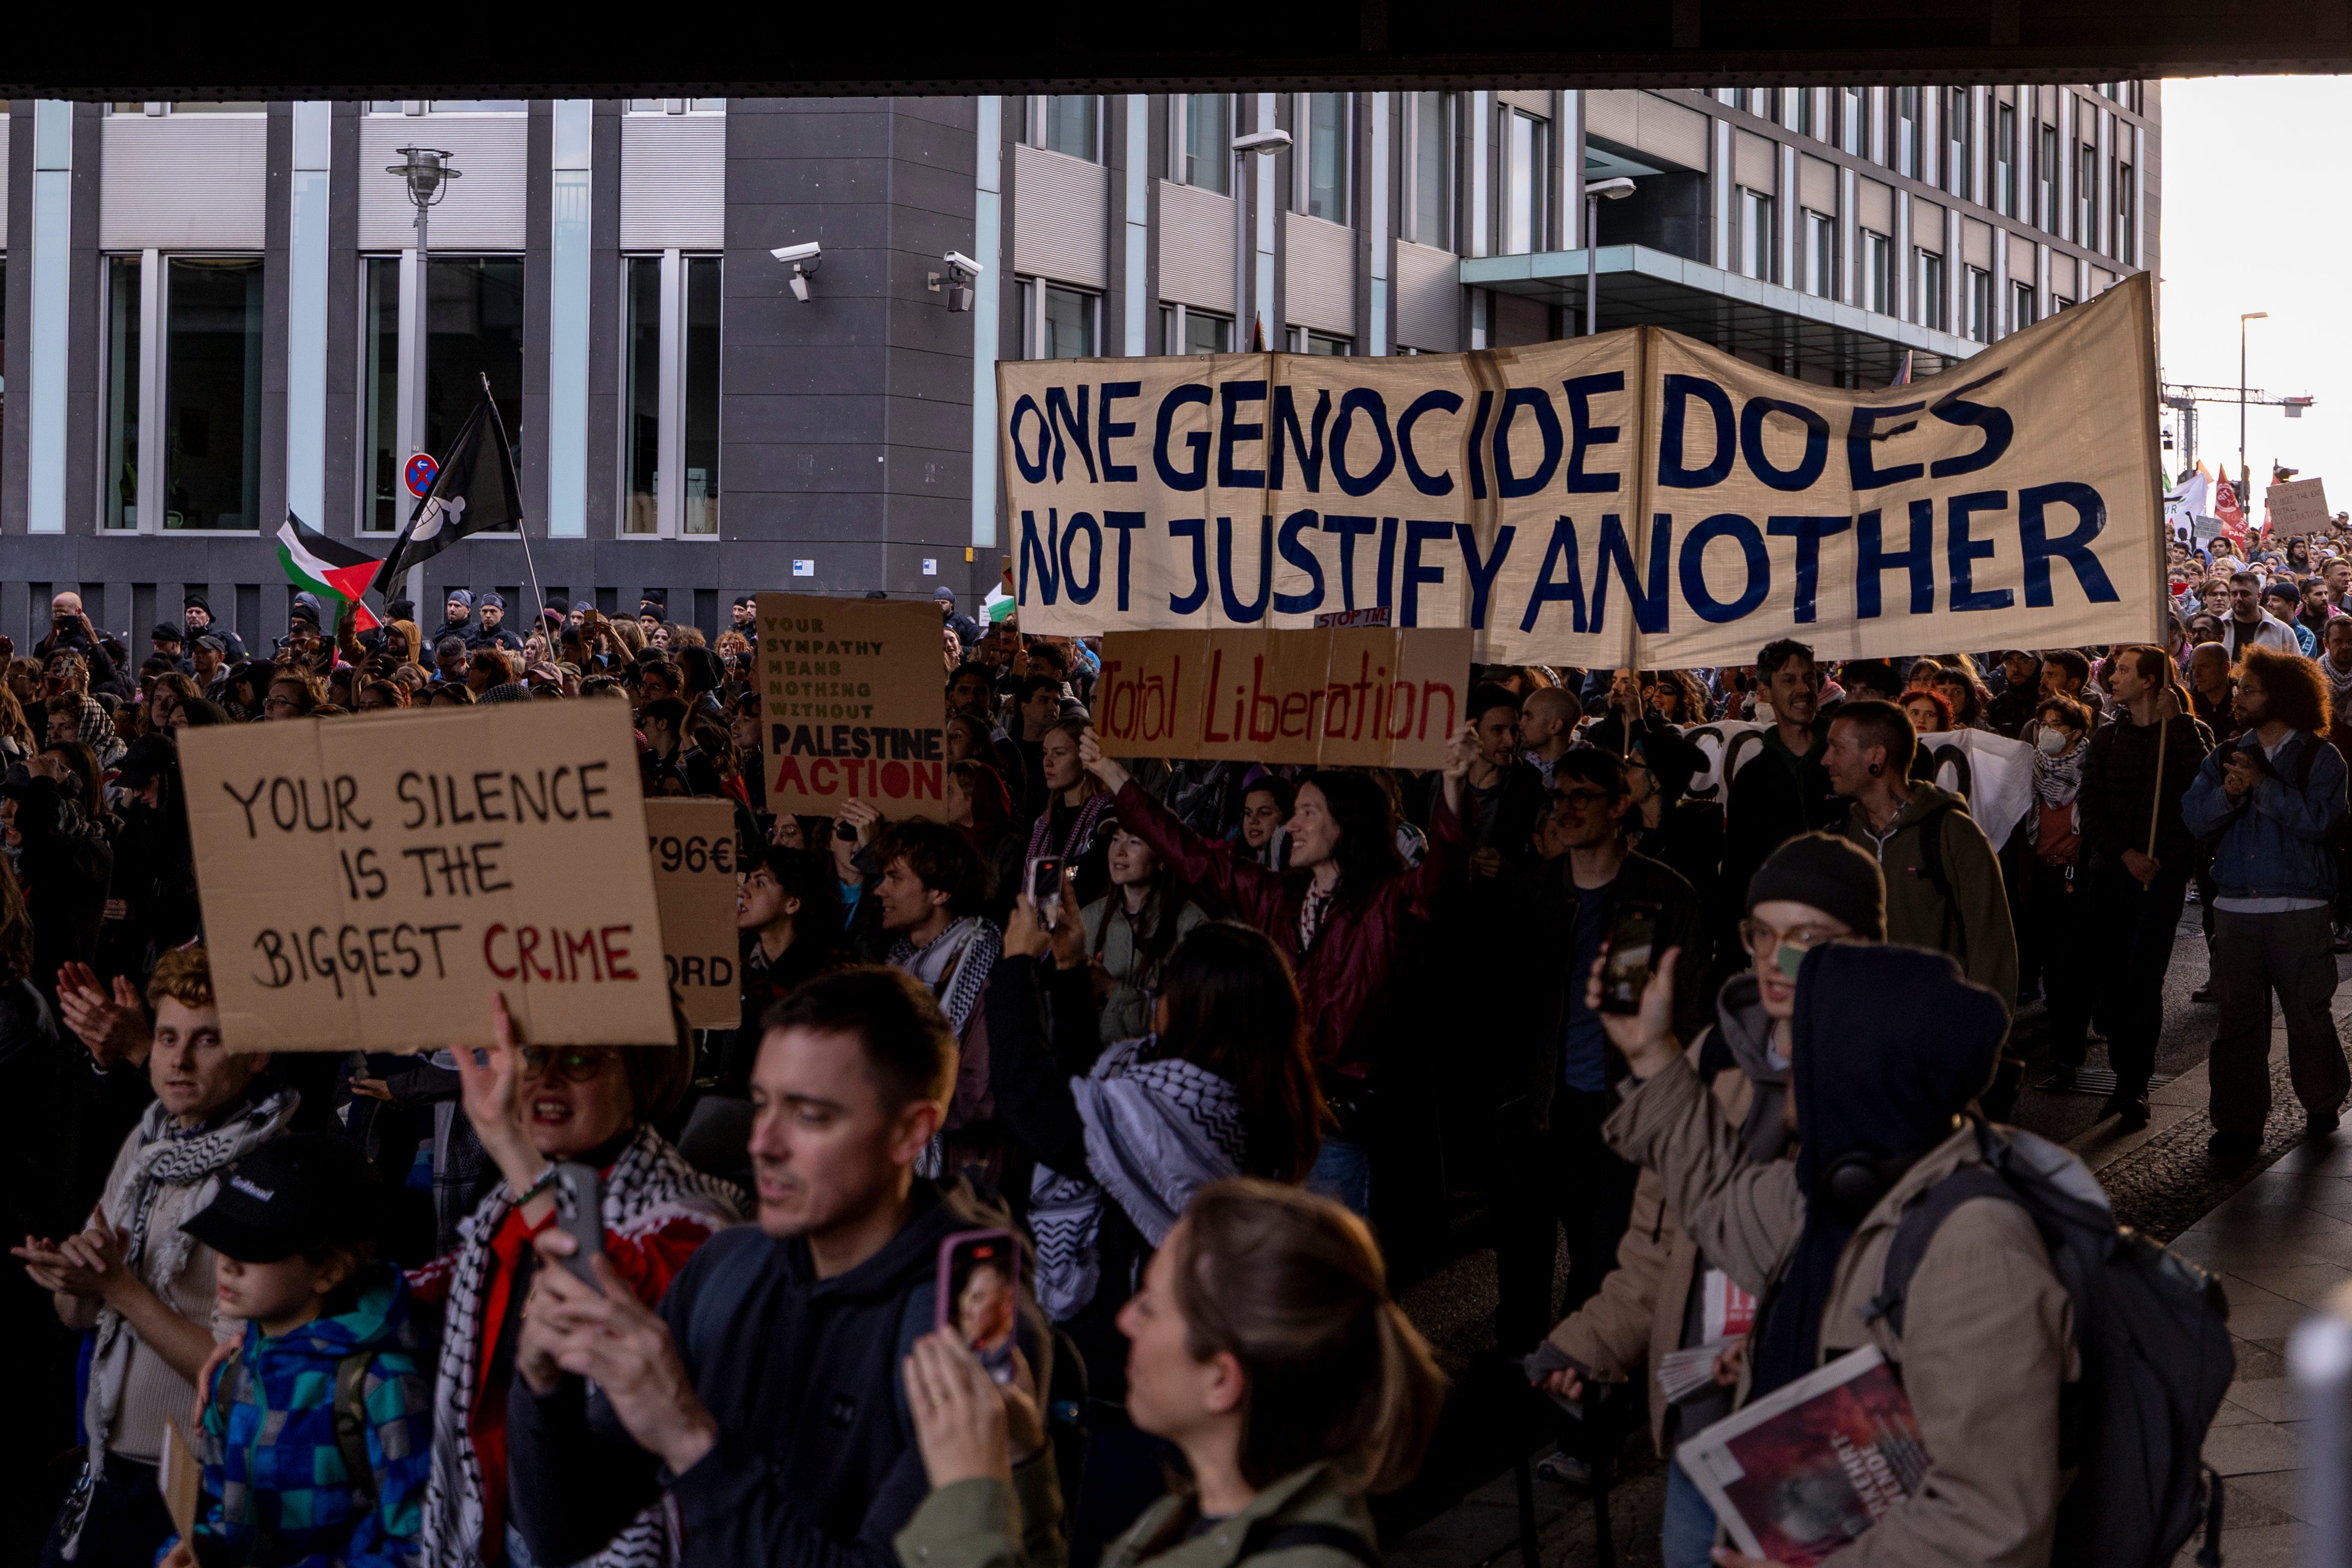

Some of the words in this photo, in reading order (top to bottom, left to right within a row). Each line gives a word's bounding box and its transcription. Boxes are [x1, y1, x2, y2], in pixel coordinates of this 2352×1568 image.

[1009, 381, 1141, 483] ONE
[1153, 371, 1624, 499] GENOCIDE
[1657, 367, 2014, 491] DOES
[2276, 481, 2318, 495] CEASEFIRE
[2280, 496, 2293, 504] NOT
[2271, 506, 2297, 516] TOTAL
[2274, 509, 2325, 525] LIBERATION
[1019, 507, 1146, 612] NOT
[1169, 510, 1514, 629] JUSTIFY
[1520, 481, 2120, 635] ANOTHER
[764, 616, 824, 633] YOUR
[1317, 609, 1362, 628] STOP
[1362, 606, 1390, 623] THE
[766, 638, 883, 655] SYMPATHY
[768, 660, 841, 675] MEANS
[769, 681, 871, 697] NOTHING
[1101, 655, 1179, 742] Total
[1204, 649, 1455, 743] Liberation
[769, 702, 873, 719] WITHOUT
[772, 724, 943, 761] PALESTINE
[775, 756, 942, 800] ACTION
[223, 774, 372, 840] YOUR
[397, 761, 612, 830] SILENCE
[340, 847, 388, 901] IS
[402, 841, 513, 898] THE
[252, 922, 462, 999] BIGGEST
[483, 923, 640, 983] CRIME
